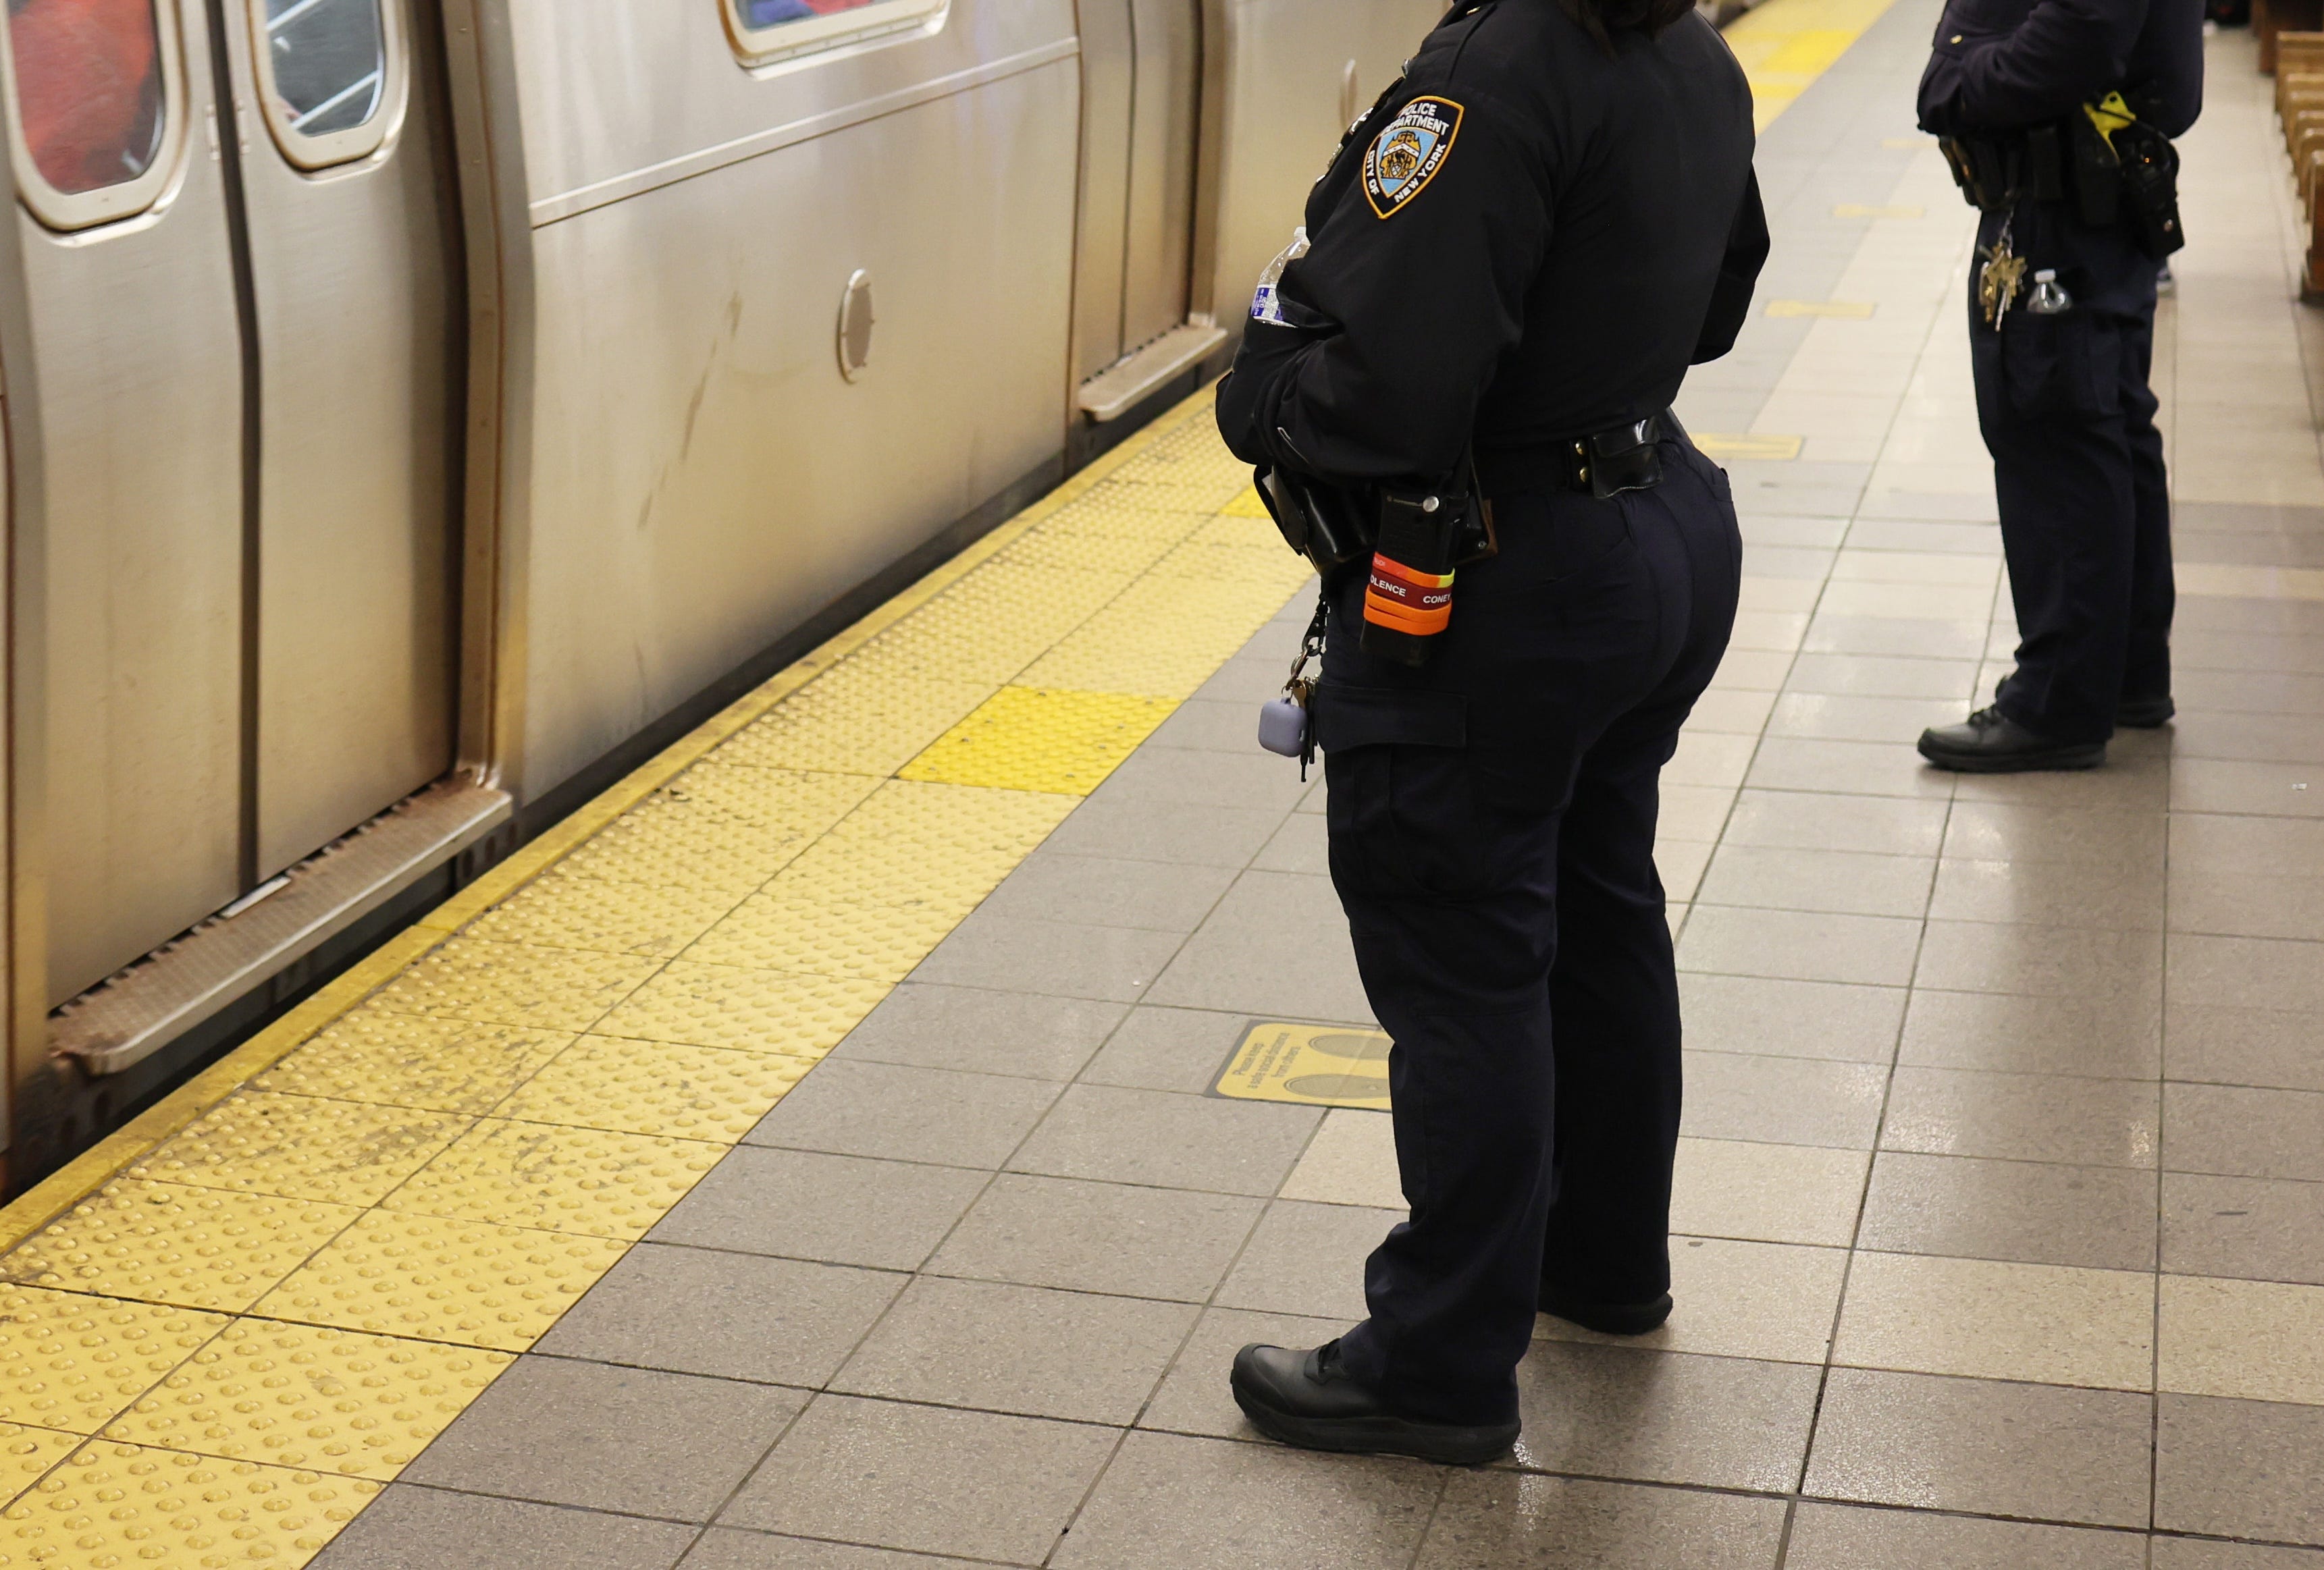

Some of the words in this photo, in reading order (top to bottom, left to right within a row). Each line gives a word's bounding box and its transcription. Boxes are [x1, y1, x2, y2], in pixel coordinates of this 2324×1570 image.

[1367, 150, 1375, 177] CITY
[1394, 178, 1419, 202] NEW
[1418, 144, 1446, 178] YORK
[1369, 179, 1380, 194] OF
